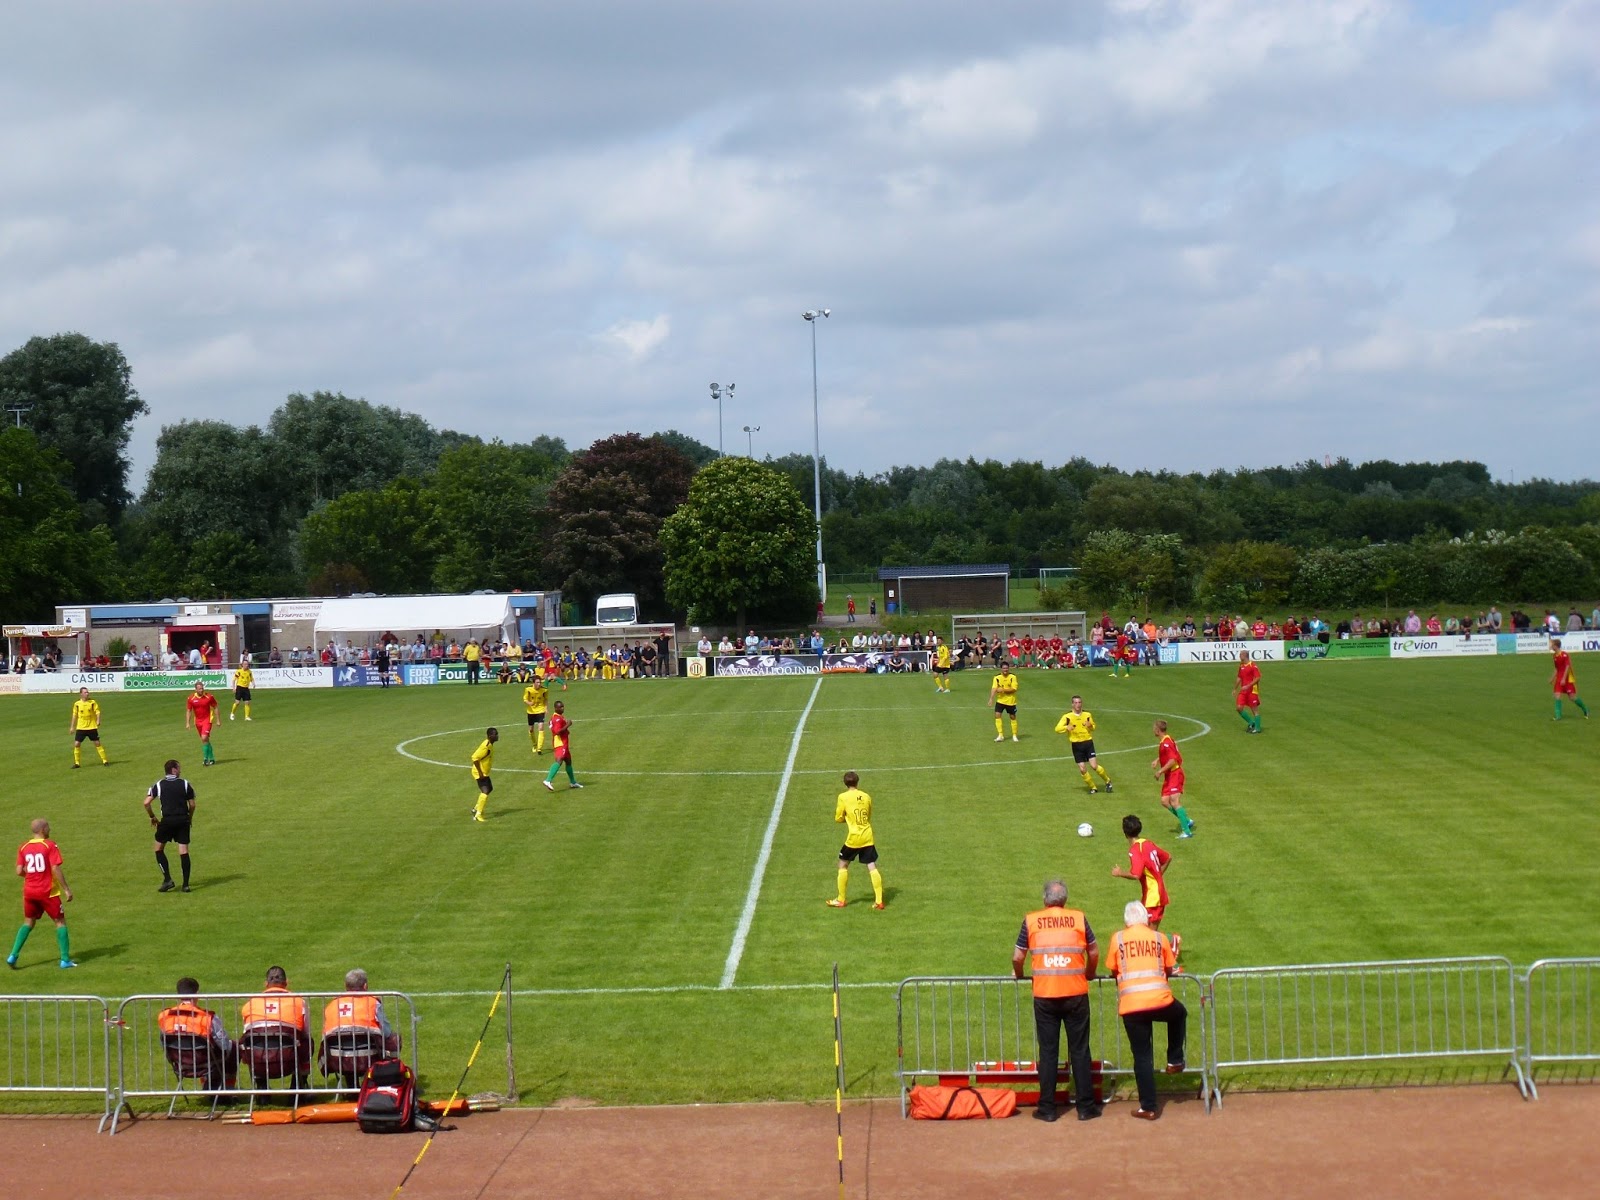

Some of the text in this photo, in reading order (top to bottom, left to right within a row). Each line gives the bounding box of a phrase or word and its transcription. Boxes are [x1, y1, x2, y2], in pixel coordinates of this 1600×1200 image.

[71, 673, 115, 684] CASIER
[275, 669, 323, 678] BRAEMS
[409, 668, 436, 677] EDDY
[409, 676, 436, 685] LUST
[25, 852, 46, 873] 20
[1037, 916, 1075, 930] STEWARD
[1119, 939, 1162, 960] STEWARD
[1043, 953, 1072, 968] lotto
